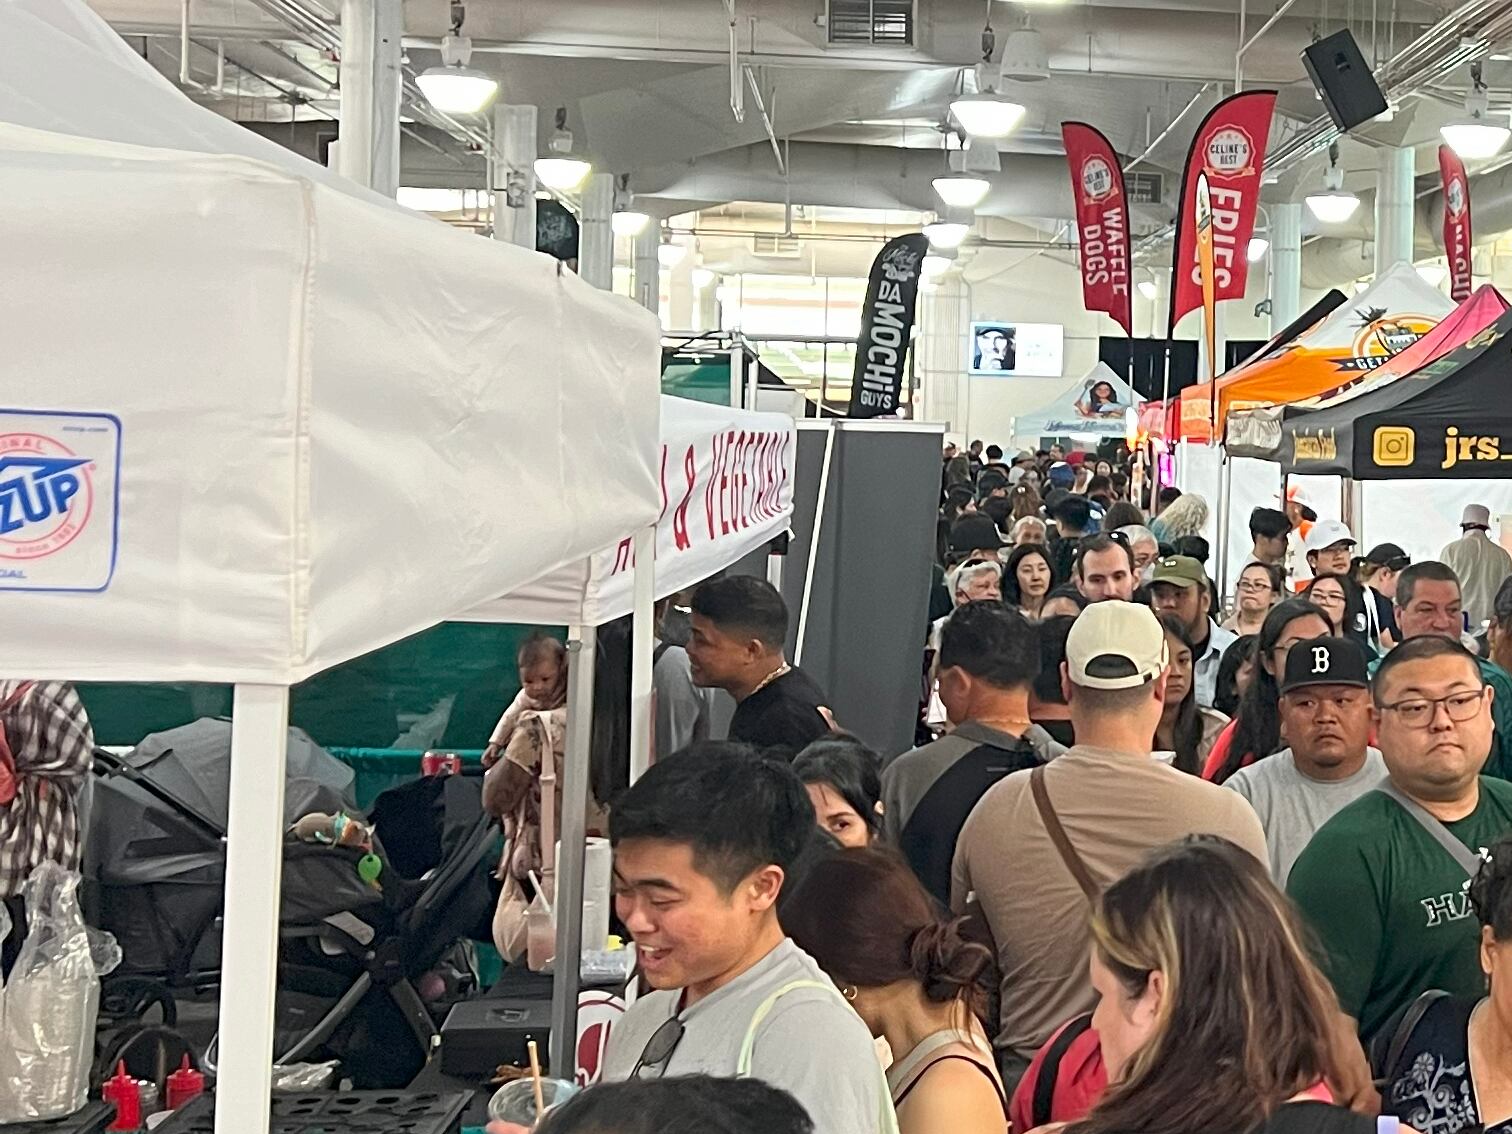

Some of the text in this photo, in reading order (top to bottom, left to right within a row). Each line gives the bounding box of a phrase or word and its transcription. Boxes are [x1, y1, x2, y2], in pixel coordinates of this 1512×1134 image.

[1083, 224, 1109, 285] DOGS
[1102, 207, 1128, 297] WAFFLE
[878, 281, 902, 303] DA
[860, 389, 892, 409] GUYS
[1311, 646, 1330, 673] B
